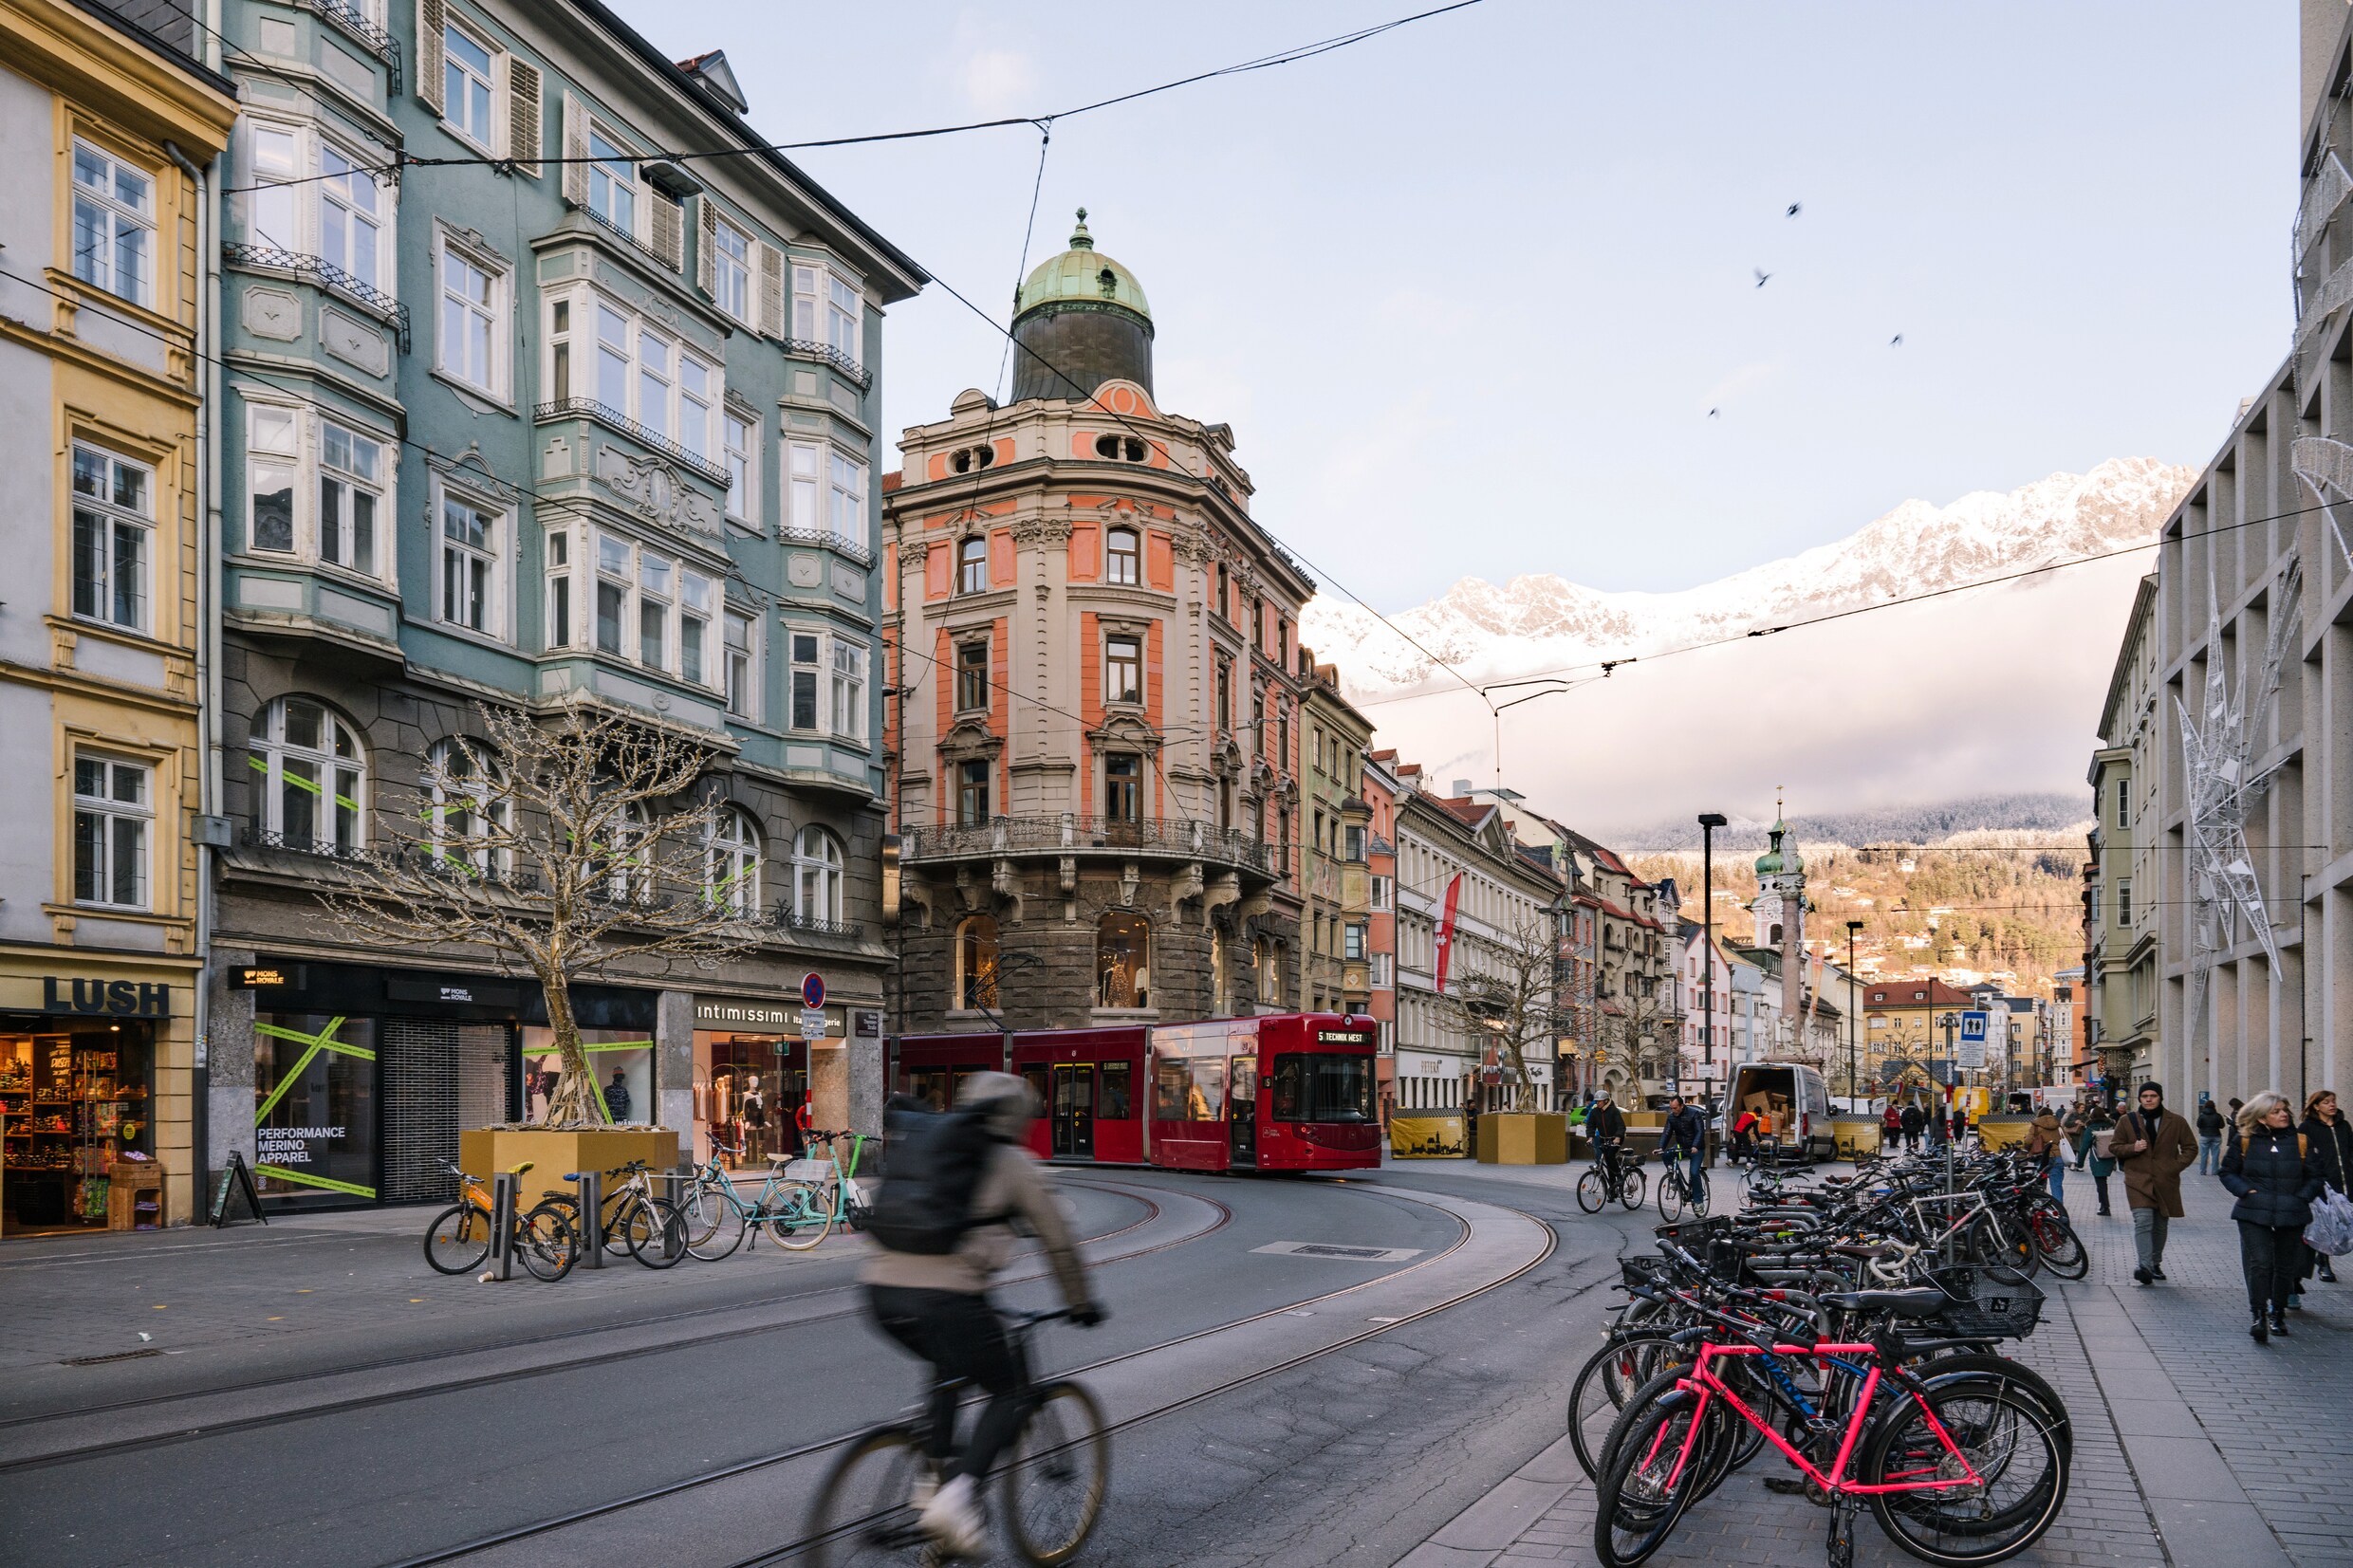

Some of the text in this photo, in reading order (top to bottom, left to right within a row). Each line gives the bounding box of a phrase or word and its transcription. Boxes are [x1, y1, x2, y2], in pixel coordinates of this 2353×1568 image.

[44, 976, 170, 1014] LUSH
[824, 1018, 841, 1028] gerie
[1325, 1033, 1347, 1042] TECHNIK
[1348, 1034, 1362, 1042] WEST
[257, 1127, 345, 1139] PERFORMANCE
[257, 1139, 305, 1152] MERINO
[257, 1152, 312, 1164] APPAREL
[1759, 1353, 1808, 1411] GIANT
[1735, 1399, 1769, 1430] HERCULES
